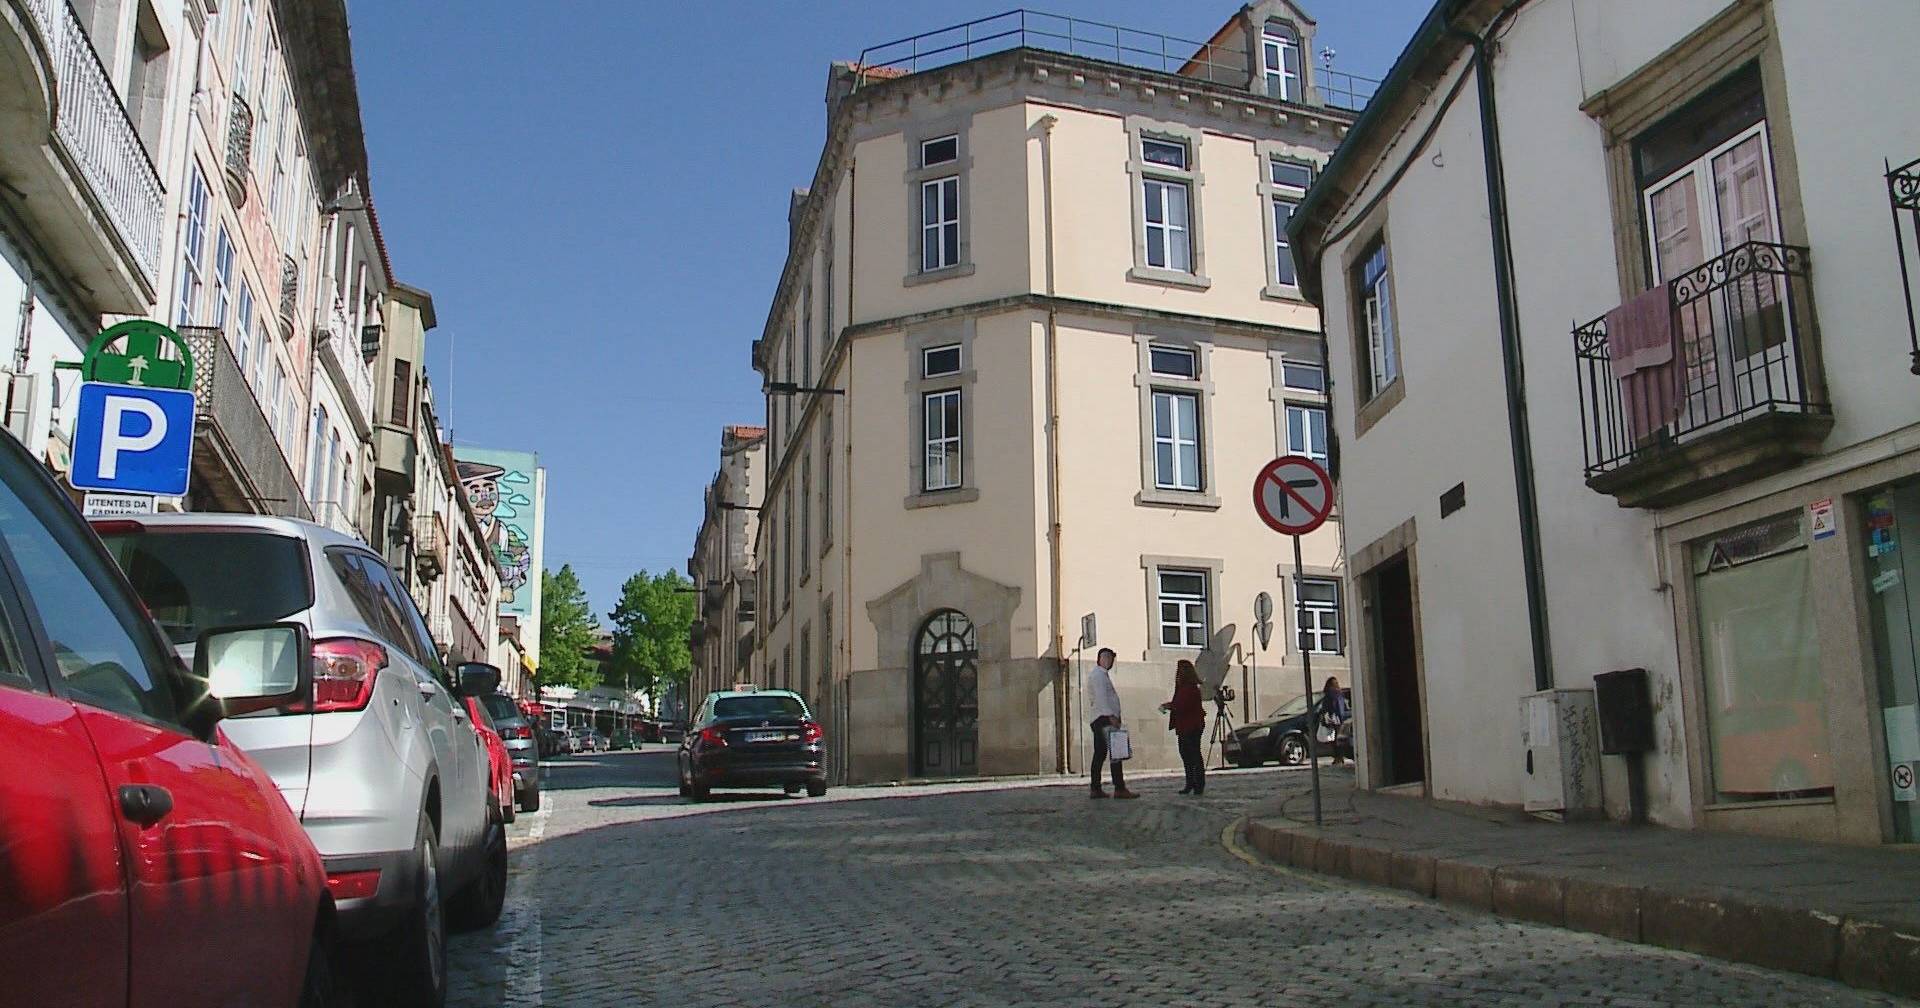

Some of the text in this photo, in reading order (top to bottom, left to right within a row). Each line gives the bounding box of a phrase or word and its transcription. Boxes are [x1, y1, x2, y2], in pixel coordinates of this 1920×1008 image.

[98, 394, 168, 480] P
[88, 498, 147, 508] UTENTES DA
